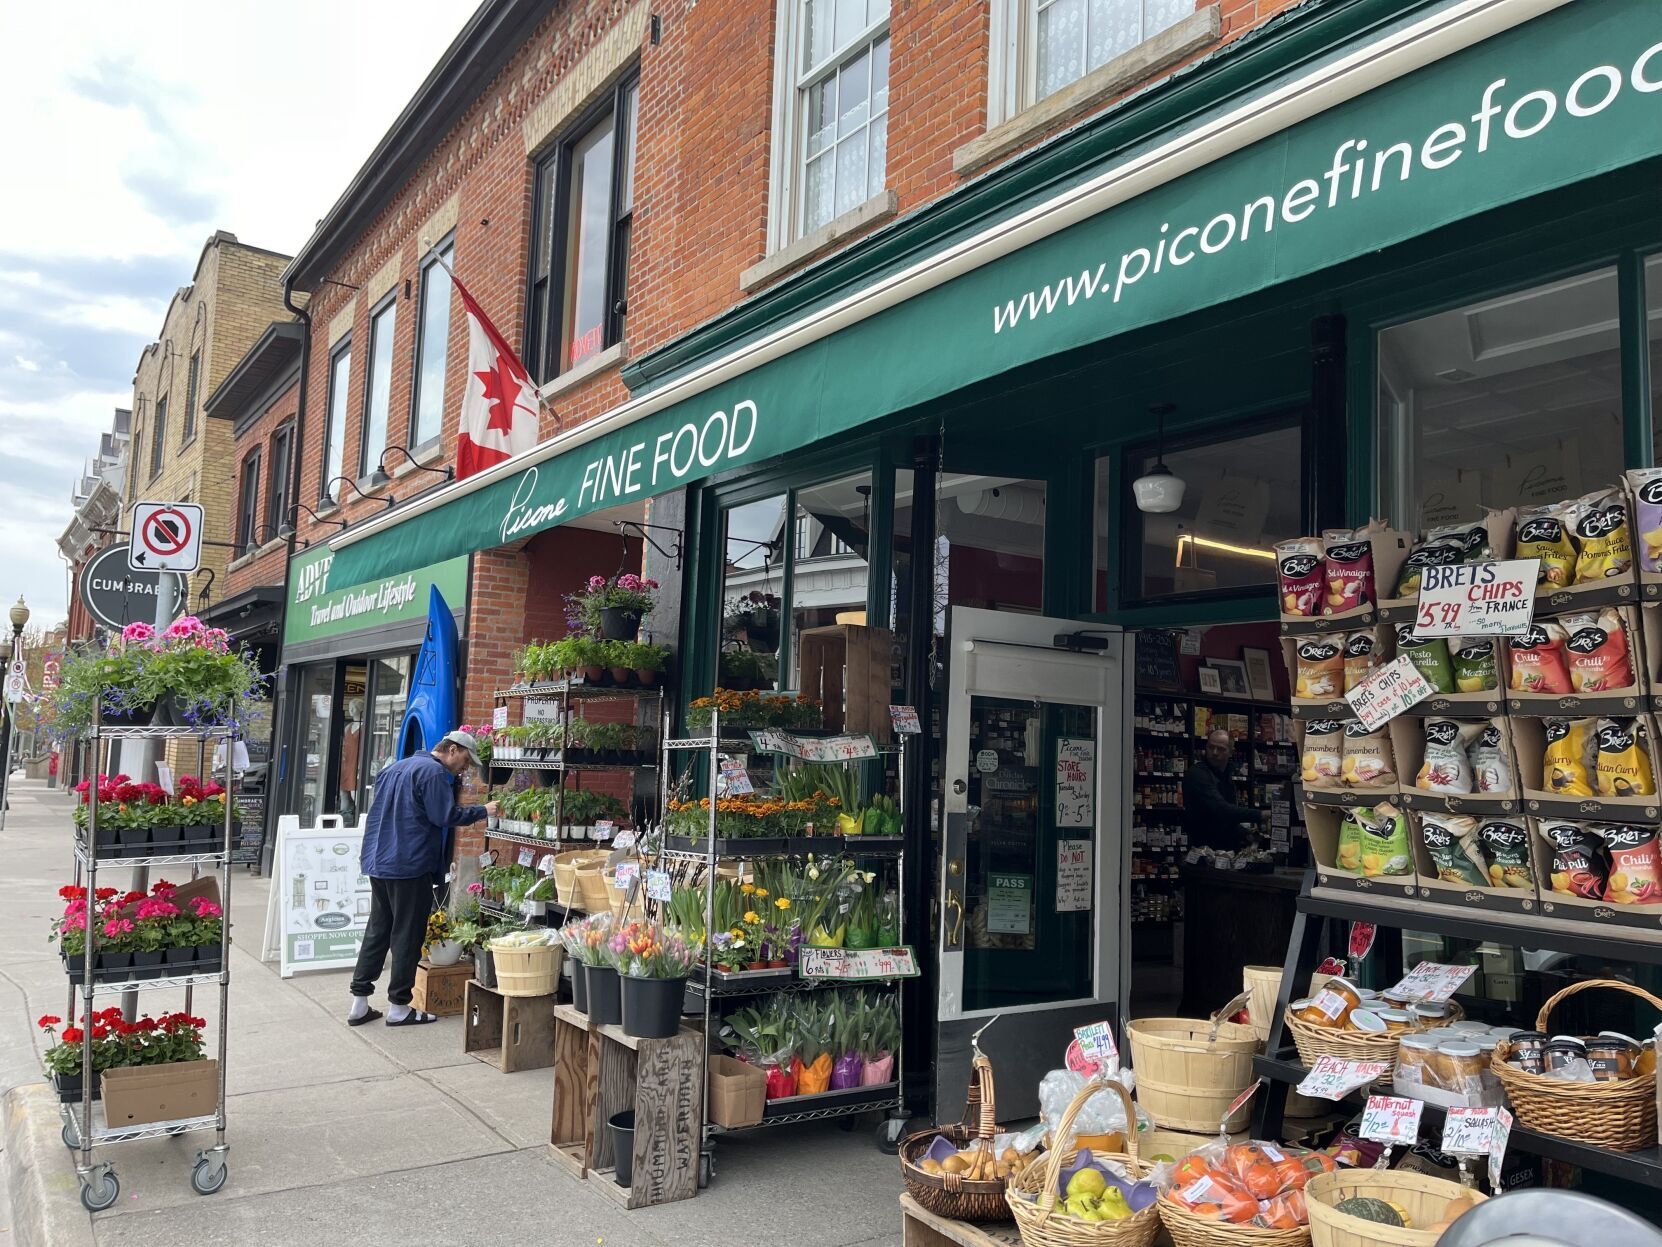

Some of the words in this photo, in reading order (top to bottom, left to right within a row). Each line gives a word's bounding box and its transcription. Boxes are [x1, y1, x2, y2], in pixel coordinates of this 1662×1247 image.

[578, 442, 645, 508] FINE
[652, 400, 757, 486] FOOD
[1612, 544, 1630, 555] Frite
[1422, 563, 1497, 591] BRETS
[1468, 581, 1523, 602] CHIPS
[310, 600, 332, 626] Travel
[331, 595, 346, 621] and
[345, 589, 378, 617] Outdoor
[377, 574, 416, 614] Lifestyle
[1485, 599, 1529, 615] FRANCE
[1410, 650, 1432, 659] Pesto
[1378, 669, 1401, 690] CHIPS
[1057, 760, 1080, 772] STORE
[1067, 771, 1087, 782] HOURS
[1482, 827, 1524, 846] Brets
[1062, 840, 1082, 852] Please
[1071, 851, 1085, 865] NOT
[996, 878, 1025, 888] PASS
[297, 932, 328, 941] SHOPPE
[329, 930, 347, 939] NOW
[348, 929, 366, 938] OPE
[805, 957, 814, 975] 6
[1077, 1024, 1105, 1040] BARTLETT
[1314, 1056, 1349, 1075] PEACH
[1367, 1095, 1414, 1111] Butternut
[1391, 1109, 1416, 1118] squash
[1464, 1117, 1496, 1129] SQUASH
[1510, 1167, 1534, 1186] GESEX
